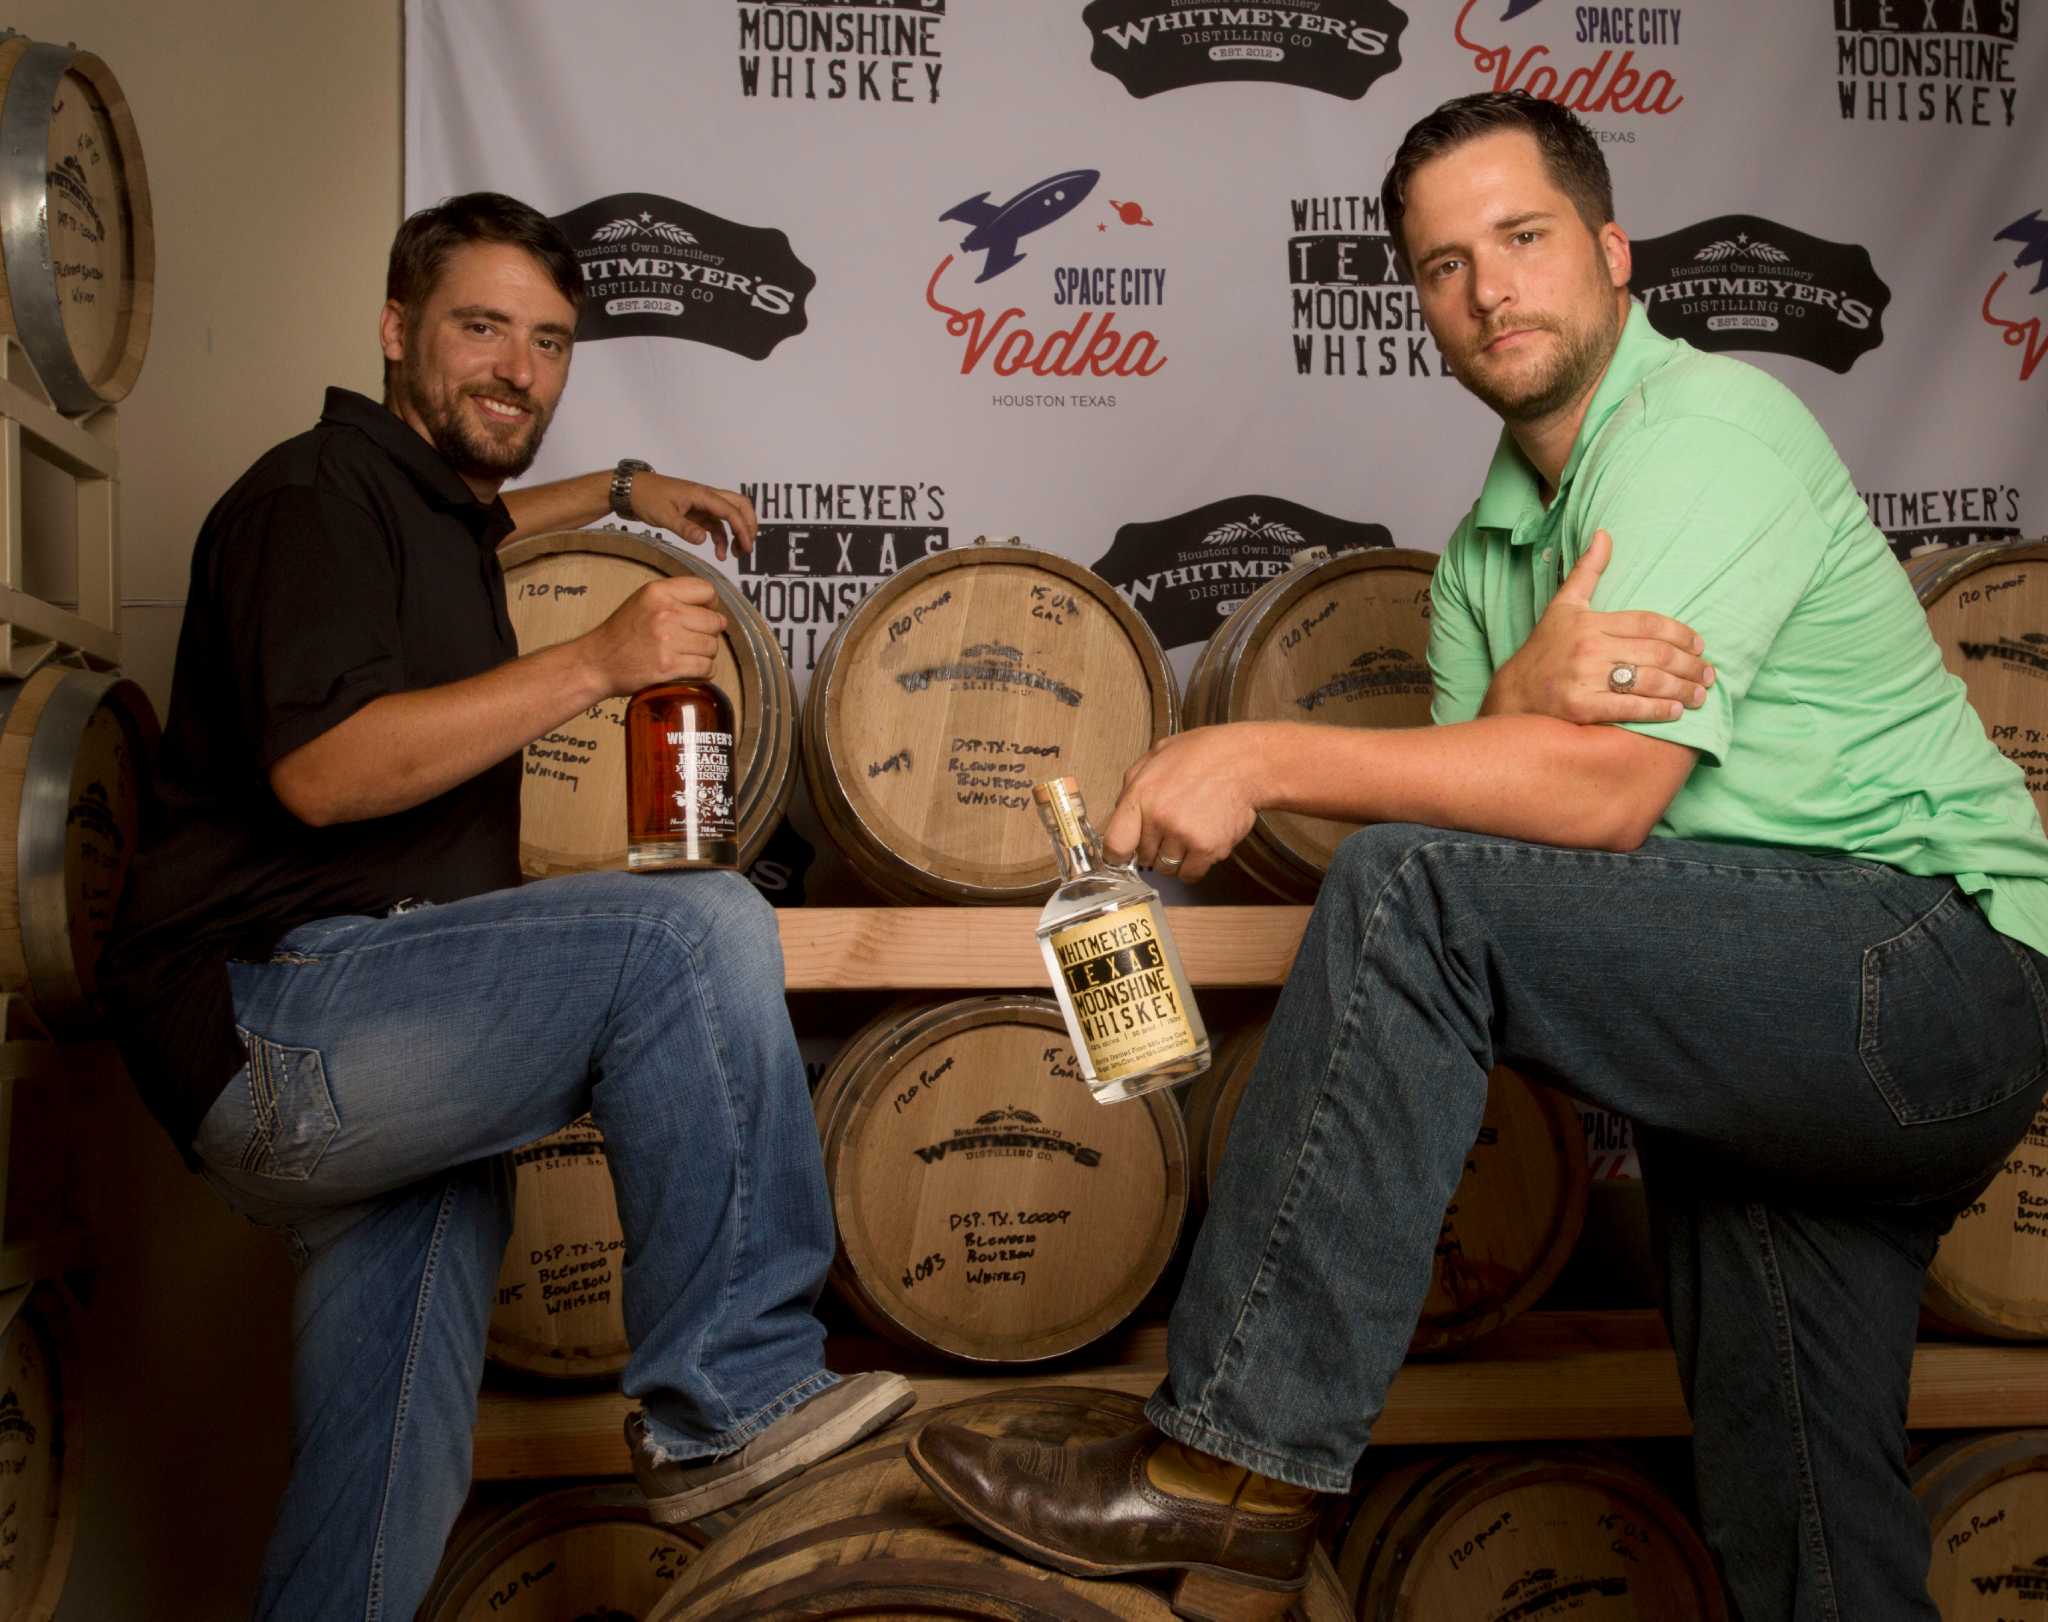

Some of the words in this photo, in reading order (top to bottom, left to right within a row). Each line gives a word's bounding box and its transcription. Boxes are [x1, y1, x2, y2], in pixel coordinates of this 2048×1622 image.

[739, 8, 942, 57] MOONSHINE
[1102, 8, 1388, 56] WHITMEYER'S
[1182, 29, 1284, 45] DISTILLING
[1290, 36, 1312, 48] CO
[1575, 6, 1635, 44] SPACE
[1638, 8, 1681, 45] CITY
[1219, 48, 1242, 58] EST.
[1245, 48, 1273, 58] 2012
[1837, 35, 2016, 82] MOONSHINE
[739, 55, 943, 104] WHISKEY
[1838, 80, 2017, 127] WHISKEY
[1594, 130, 1636, 143] TEXAS
[1291, 196, 1394, 231] WHITM
[574, 243, 627, 257] ouston's
[631, 242, 659, 254] Own
[663, 245, 725, 266] Distillery
[1295, 242, 1399, 282] TEX
[580, 258, 795, 315] ITMEYER'S
[1054, 267, 1116, 306] SPACE
[1120, 268, 1166, 306] CITY
[1671, 263, 1727, 278] Houston's
[1730, 262, 1754, 274] Own
[1758, 264, 1815, 282] Distillery
[586, 281, 684, 298] ISTILLING
[691, 287, 714, 303] CO
[616, 301, 641, 311] EST.
[643, 301, 672, 312] 2012
[1292, 289, 1426, 332] MOONSH
[1682, 299, 1778, 315] DISTILLING
[1784, 306, 1806, 318] CO
[1742, 318, 1768, 328] 2012
[946, 308, 1168, 377] Vodka
[992, 395, 1065, 408] HOUSTON
[1070, 395, 1116, 408] TEXAS
[1857, 485, 2021, 528] ITMEYER'S
[1178, 546, 1239, 562] Houston's
[1241, 544, 1269, 555] Own
[519, 583, 548, 600] 120
[741, 579, 882, 623] MOONS
[1188, 582, 1258, 600] DISTIL
[1958, 590, 1981, 609] 120
[888, 616, 912, 643] 120
[1057, 918, 1152, 966] WHITMEYER'S
[1066, 943, 1161, 992] TEXAS
[1074, 968, 1171, 1019] MOONSHINE
[1082, 991, 1177, 1042] WHISKEY
[893, 1084, 918, 1115] 120
[1578, 1111, 1634, 1150] PACE
[538, 1257, 608, 1284] BLENDED
[542, 1271, 612, 1300] BOURBON
[545, 1290, 612, 1316] WHISKEY
[1448, 1541, 1474, 1570] 120
[1947, 1531, 1972, 1554] 120
